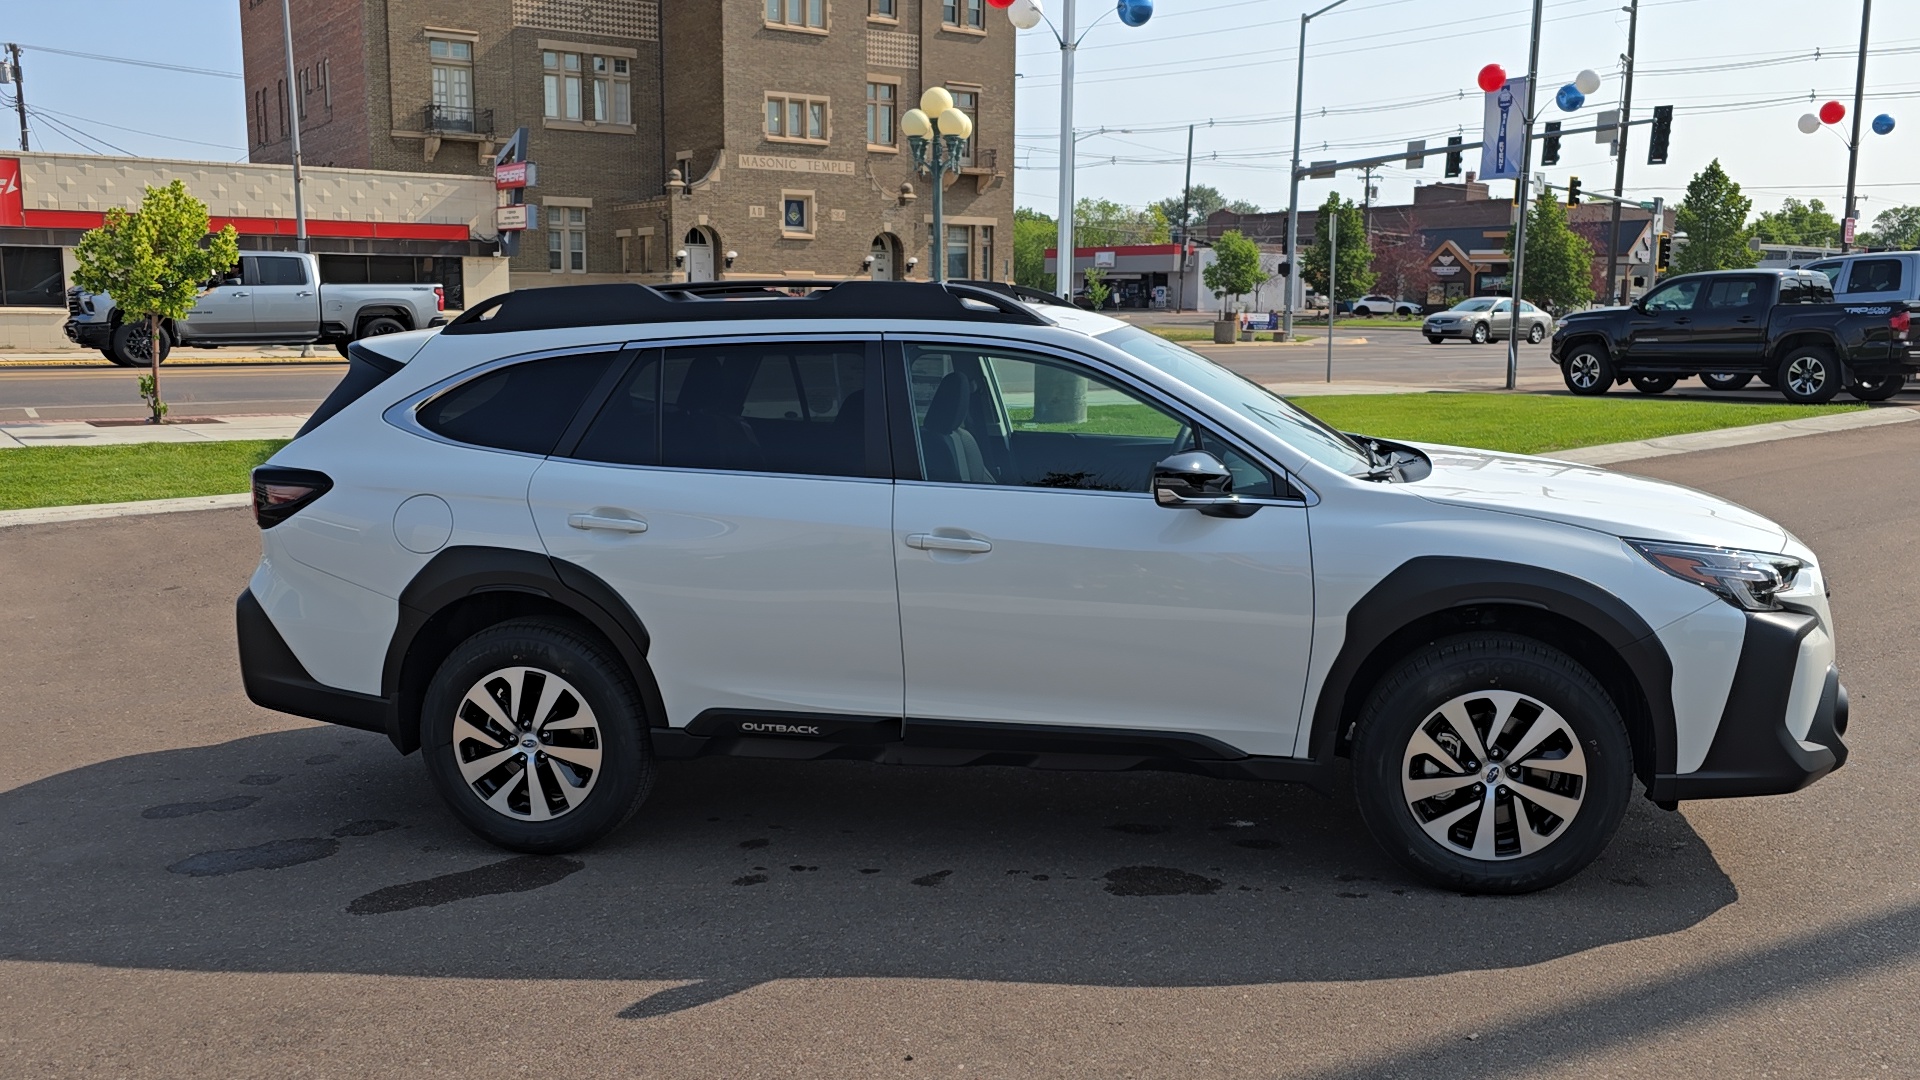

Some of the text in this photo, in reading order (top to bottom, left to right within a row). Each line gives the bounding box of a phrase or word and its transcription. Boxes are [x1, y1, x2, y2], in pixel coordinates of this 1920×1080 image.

[741, 156, 853, 173] MASONIC TEMPLE
[741, 722, 820, 735] OUTBACK
